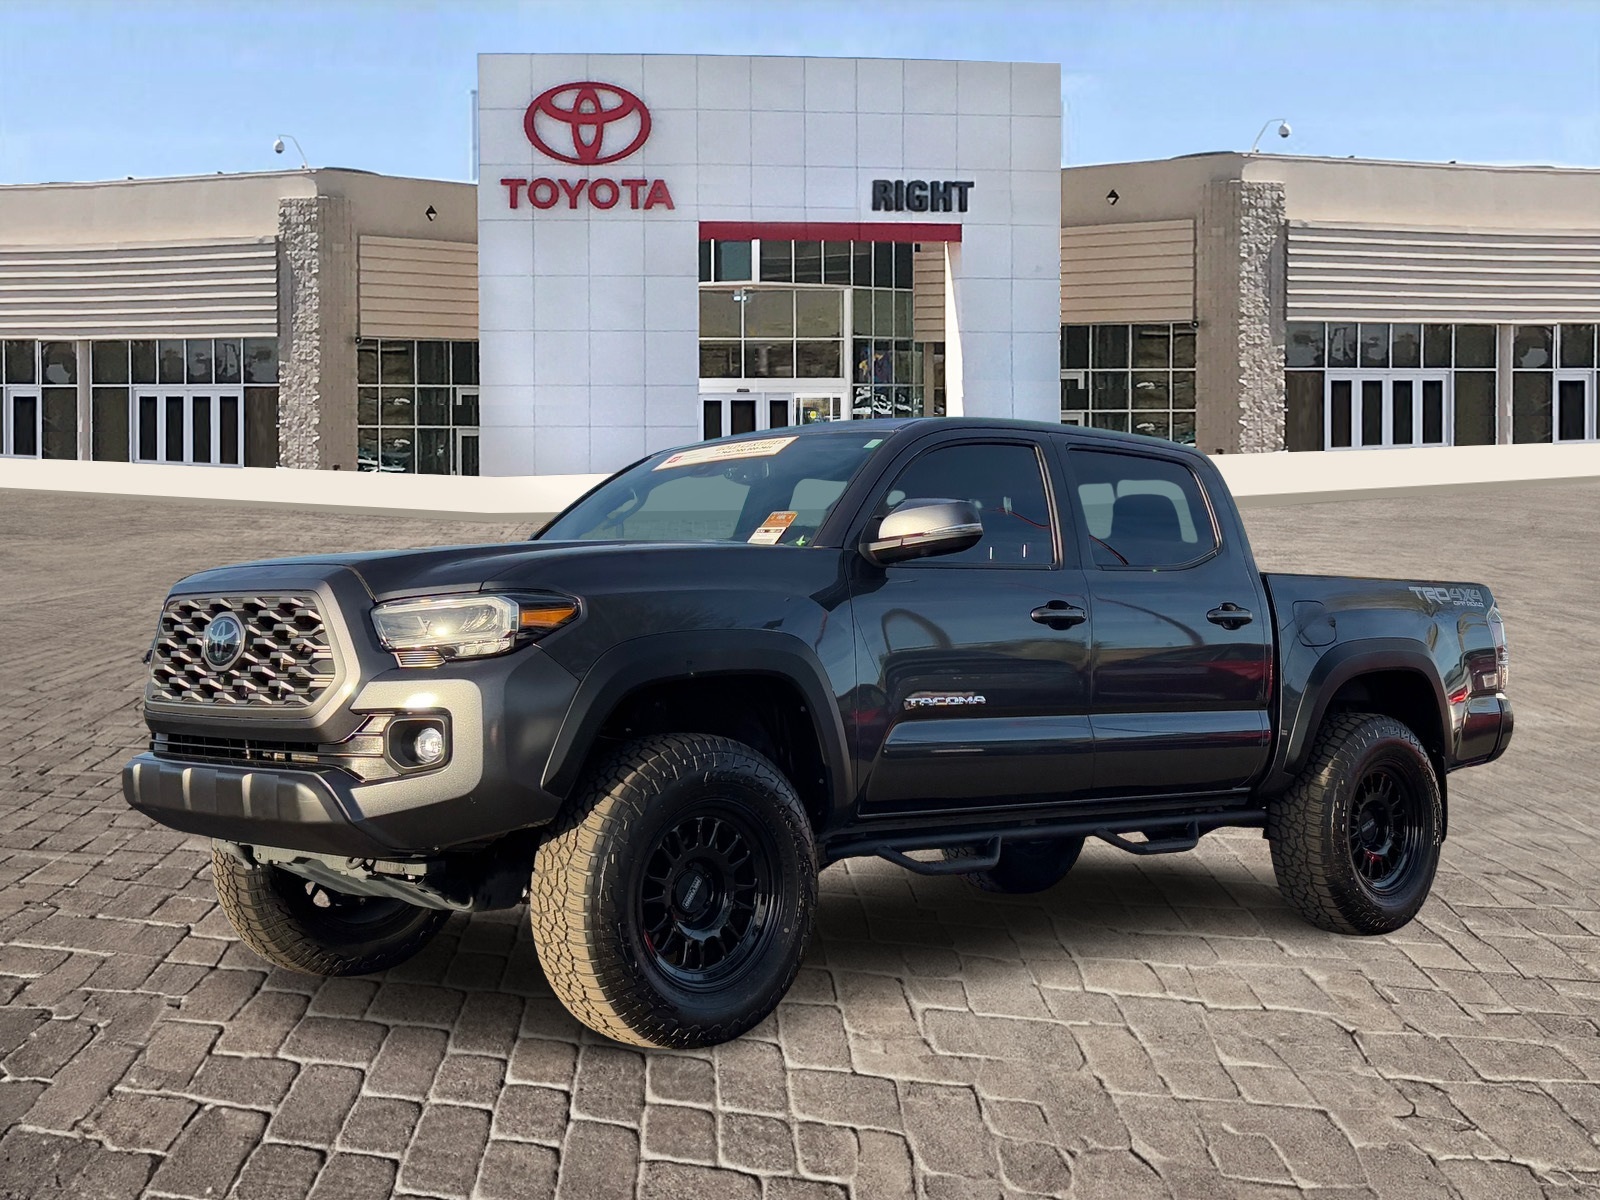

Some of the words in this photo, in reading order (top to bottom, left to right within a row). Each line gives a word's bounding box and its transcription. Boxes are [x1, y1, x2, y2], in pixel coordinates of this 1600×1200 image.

[500, 177, 675, 210] TOYOTA
[872, 179, 975, 212] RIGHT
[1408, 587, 1451, 604] TRD
[904, 695, 987, 707] TACOMA
